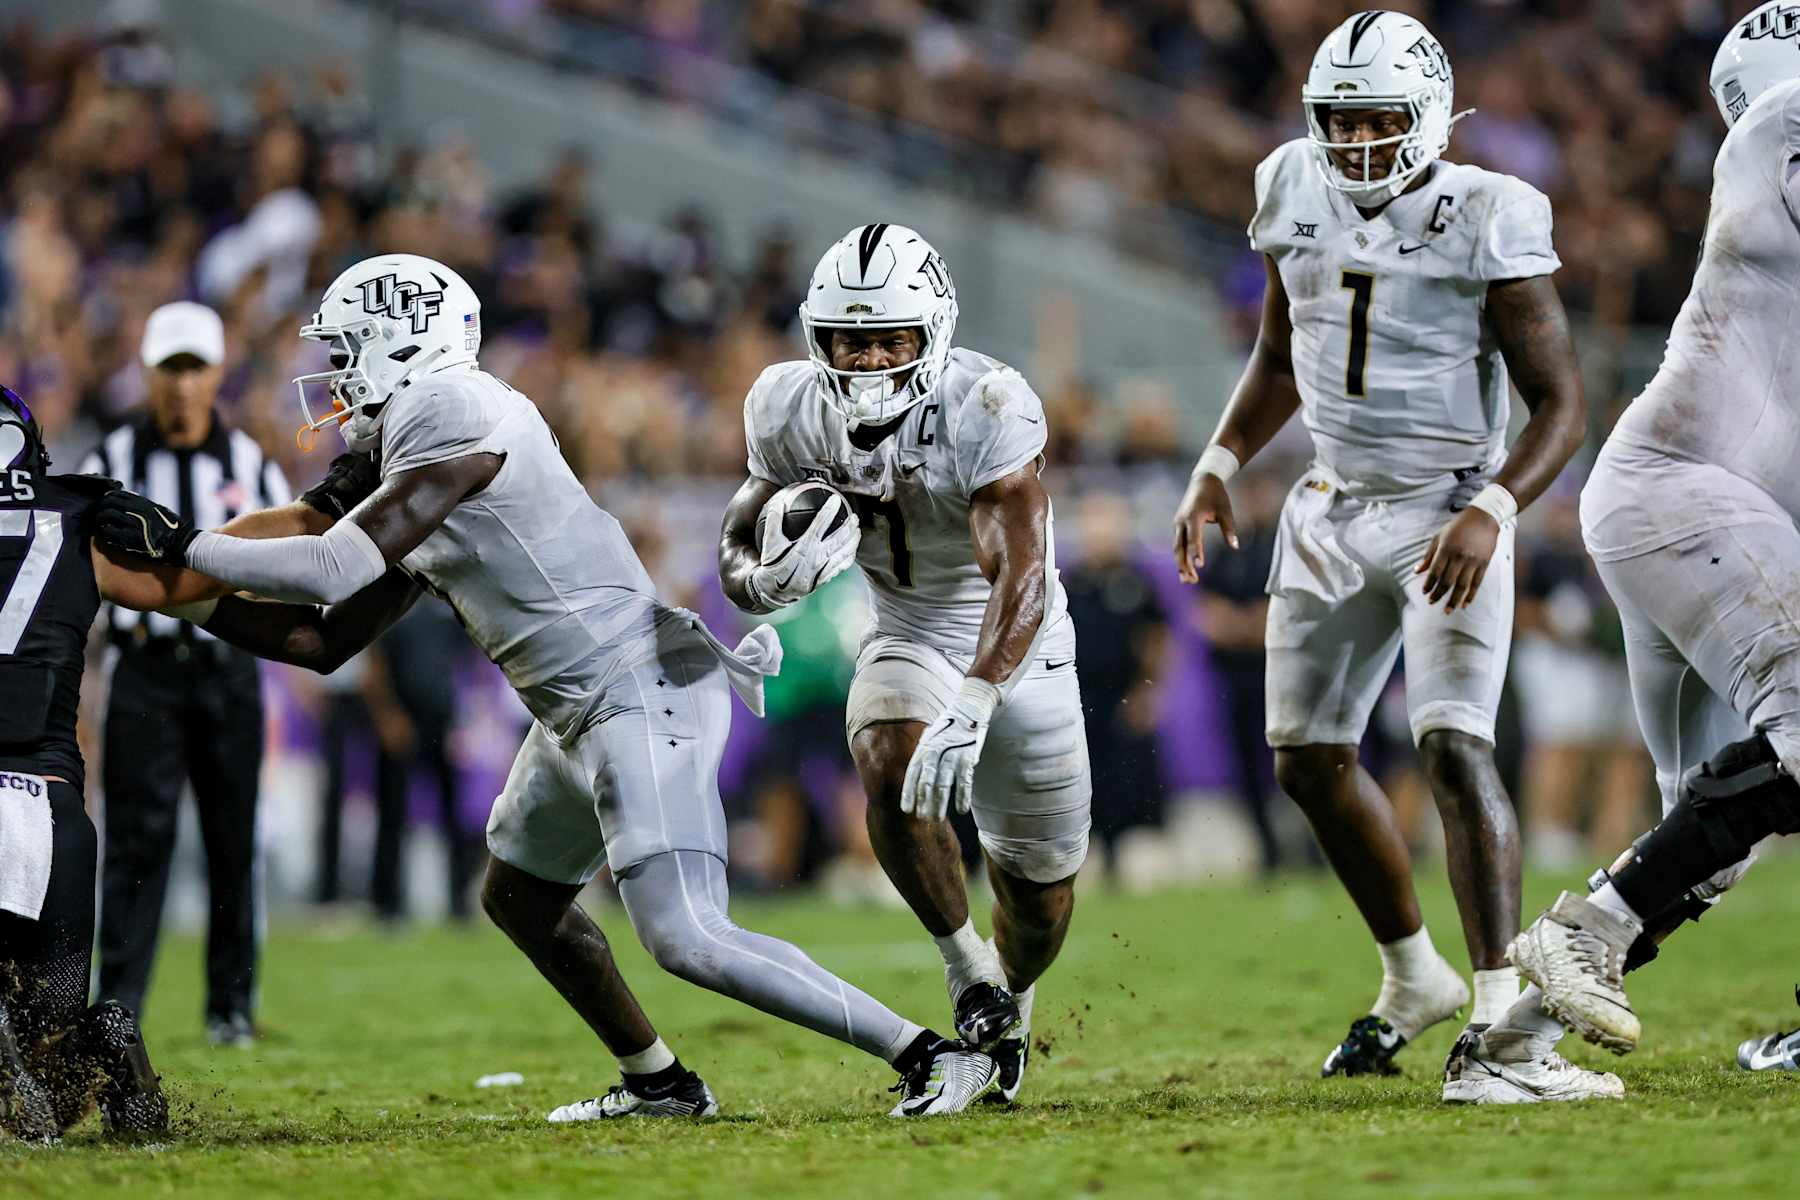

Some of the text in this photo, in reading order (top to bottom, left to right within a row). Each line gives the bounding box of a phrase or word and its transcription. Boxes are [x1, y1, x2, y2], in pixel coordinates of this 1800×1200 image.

[1739, 5, 1800, 41] UC
[1292, 222, 1319, 239] XII
[1429, 195, 1454, 234] C
[354, 273, 444, 335] UCF
[1341, 270, 1377, 397] 1
[918, 404, 939, 446] C
